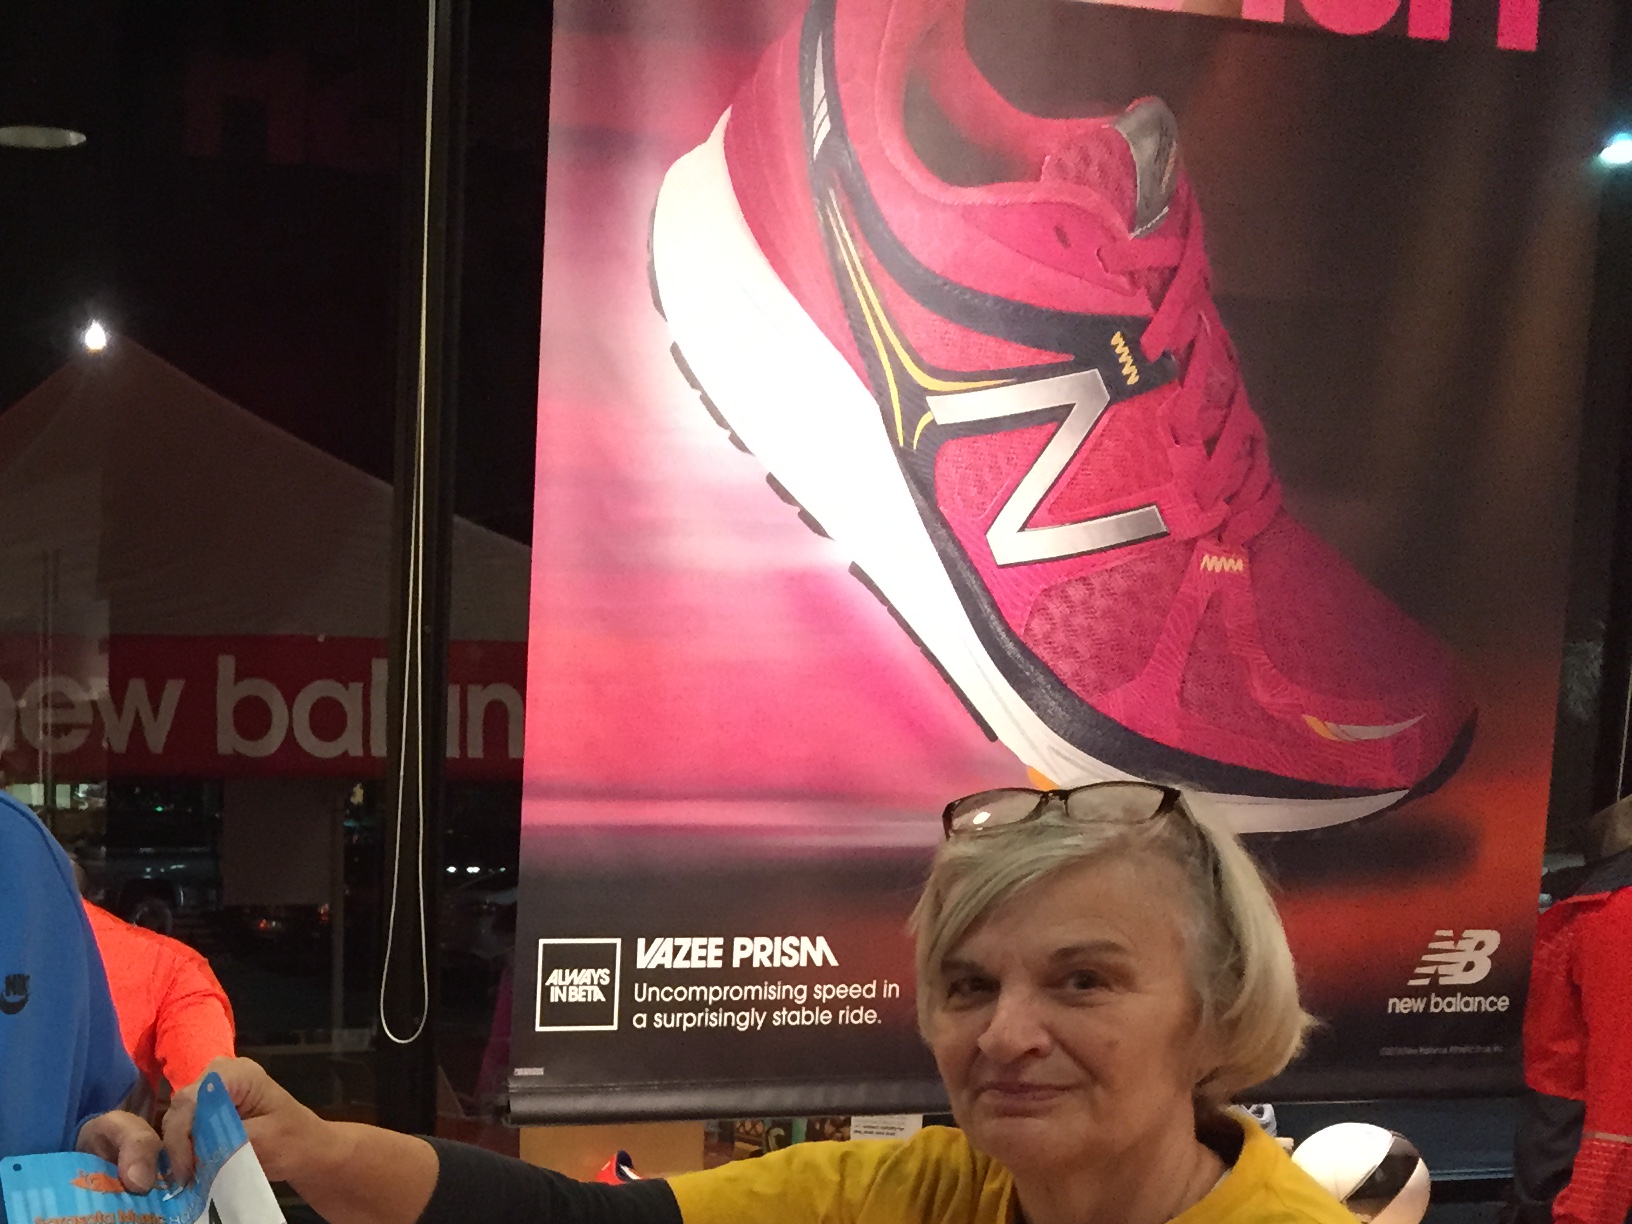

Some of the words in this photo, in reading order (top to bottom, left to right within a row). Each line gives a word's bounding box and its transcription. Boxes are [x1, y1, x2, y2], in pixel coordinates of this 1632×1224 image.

[636, 937, 724, 969] VAZEE
[732, 935, 840, 968] PRISM
[545, 968, 611, 987] ALWAYS
[549, 986, 567, 1003] IN
[567, 985, 607, 1003] BETA
[634, 981, 808, 1005] Uncompromising
[813, 979, 877, 1004] speed
[883, 981, 900, 999] in
[1387, 996, 1427, 1014] new
[1429, 993, 1510, 1013] balance
[632, 1013, 647, 1029] a
[653, 1007, 768, 1031] surprisingly
[772, 1006, 833, 1026] stable
[838, 1005, 883, 1025] ride.
